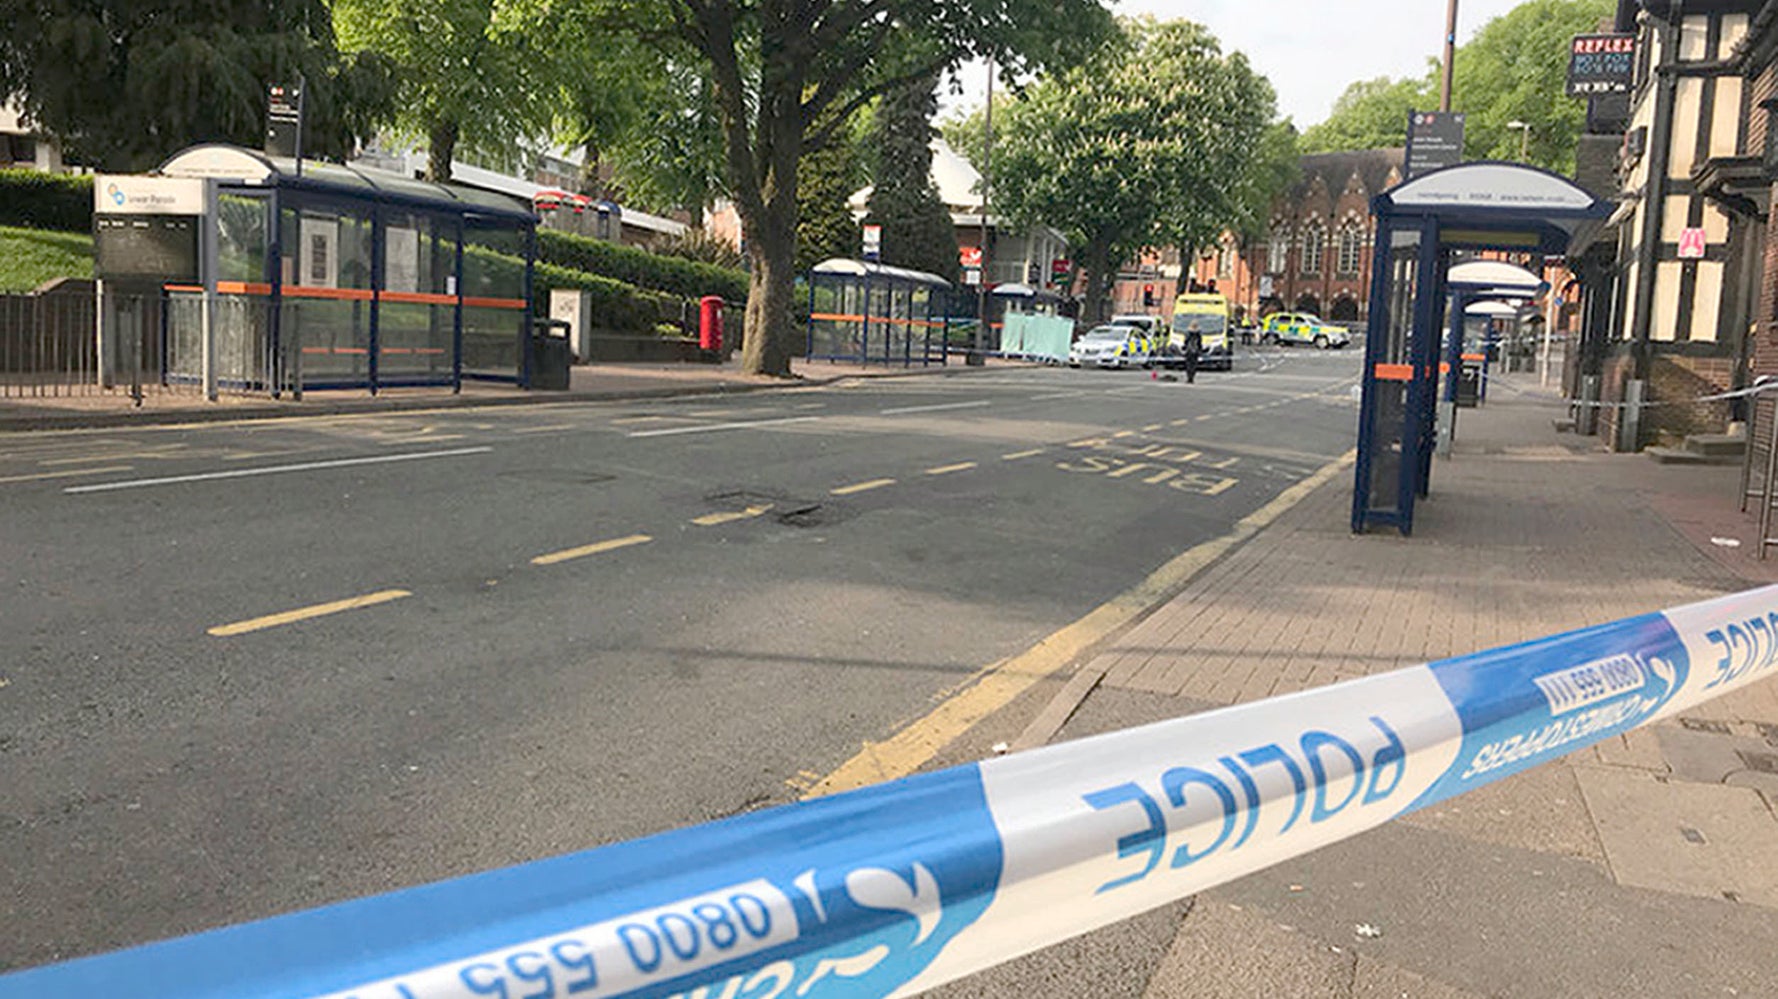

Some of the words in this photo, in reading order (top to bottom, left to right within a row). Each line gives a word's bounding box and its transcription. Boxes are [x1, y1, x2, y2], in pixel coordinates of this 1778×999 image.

[1574, 38, 1634, 53] REFLEX
[1056, 455, 1239, 496] BUS
[1571, 669, 1603, 700] 555
[1602, 657, 1639, 687] 0800
[1542, 675, 1576, 707] 111
[1082, 716, 1407, 895] POLICE
[615, 892, 773, 974] 0800
[459, 938, 600, 999] 555
